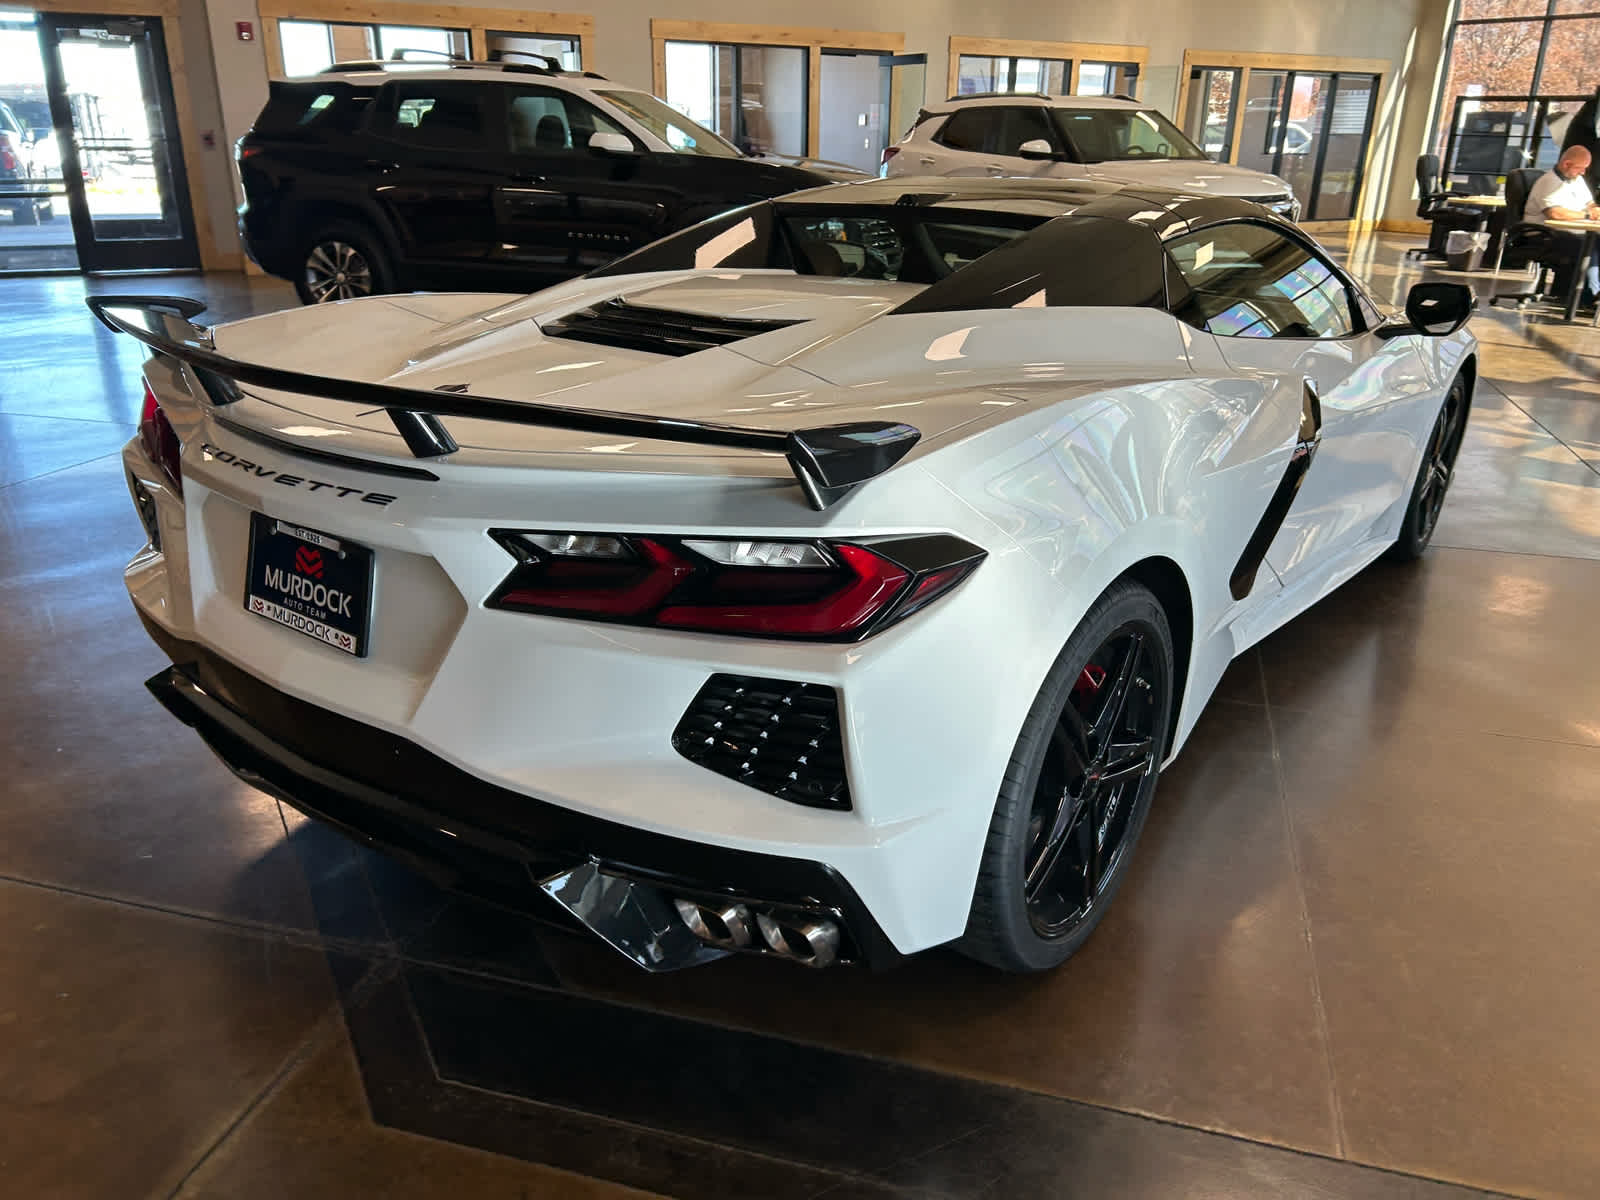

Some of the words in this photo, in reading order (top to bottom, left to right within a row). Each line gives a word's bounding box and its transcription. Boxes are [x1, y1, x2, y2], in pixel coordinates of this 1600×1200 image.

[201, 443, 398, 506] CORVETTE
[264, 564, 352, 618] MURDOCK
[283, 597, 304, 611] AUTO
[305, 605, 327, 619] TEAM
[272, 606, 331, 641] MURDOCK
